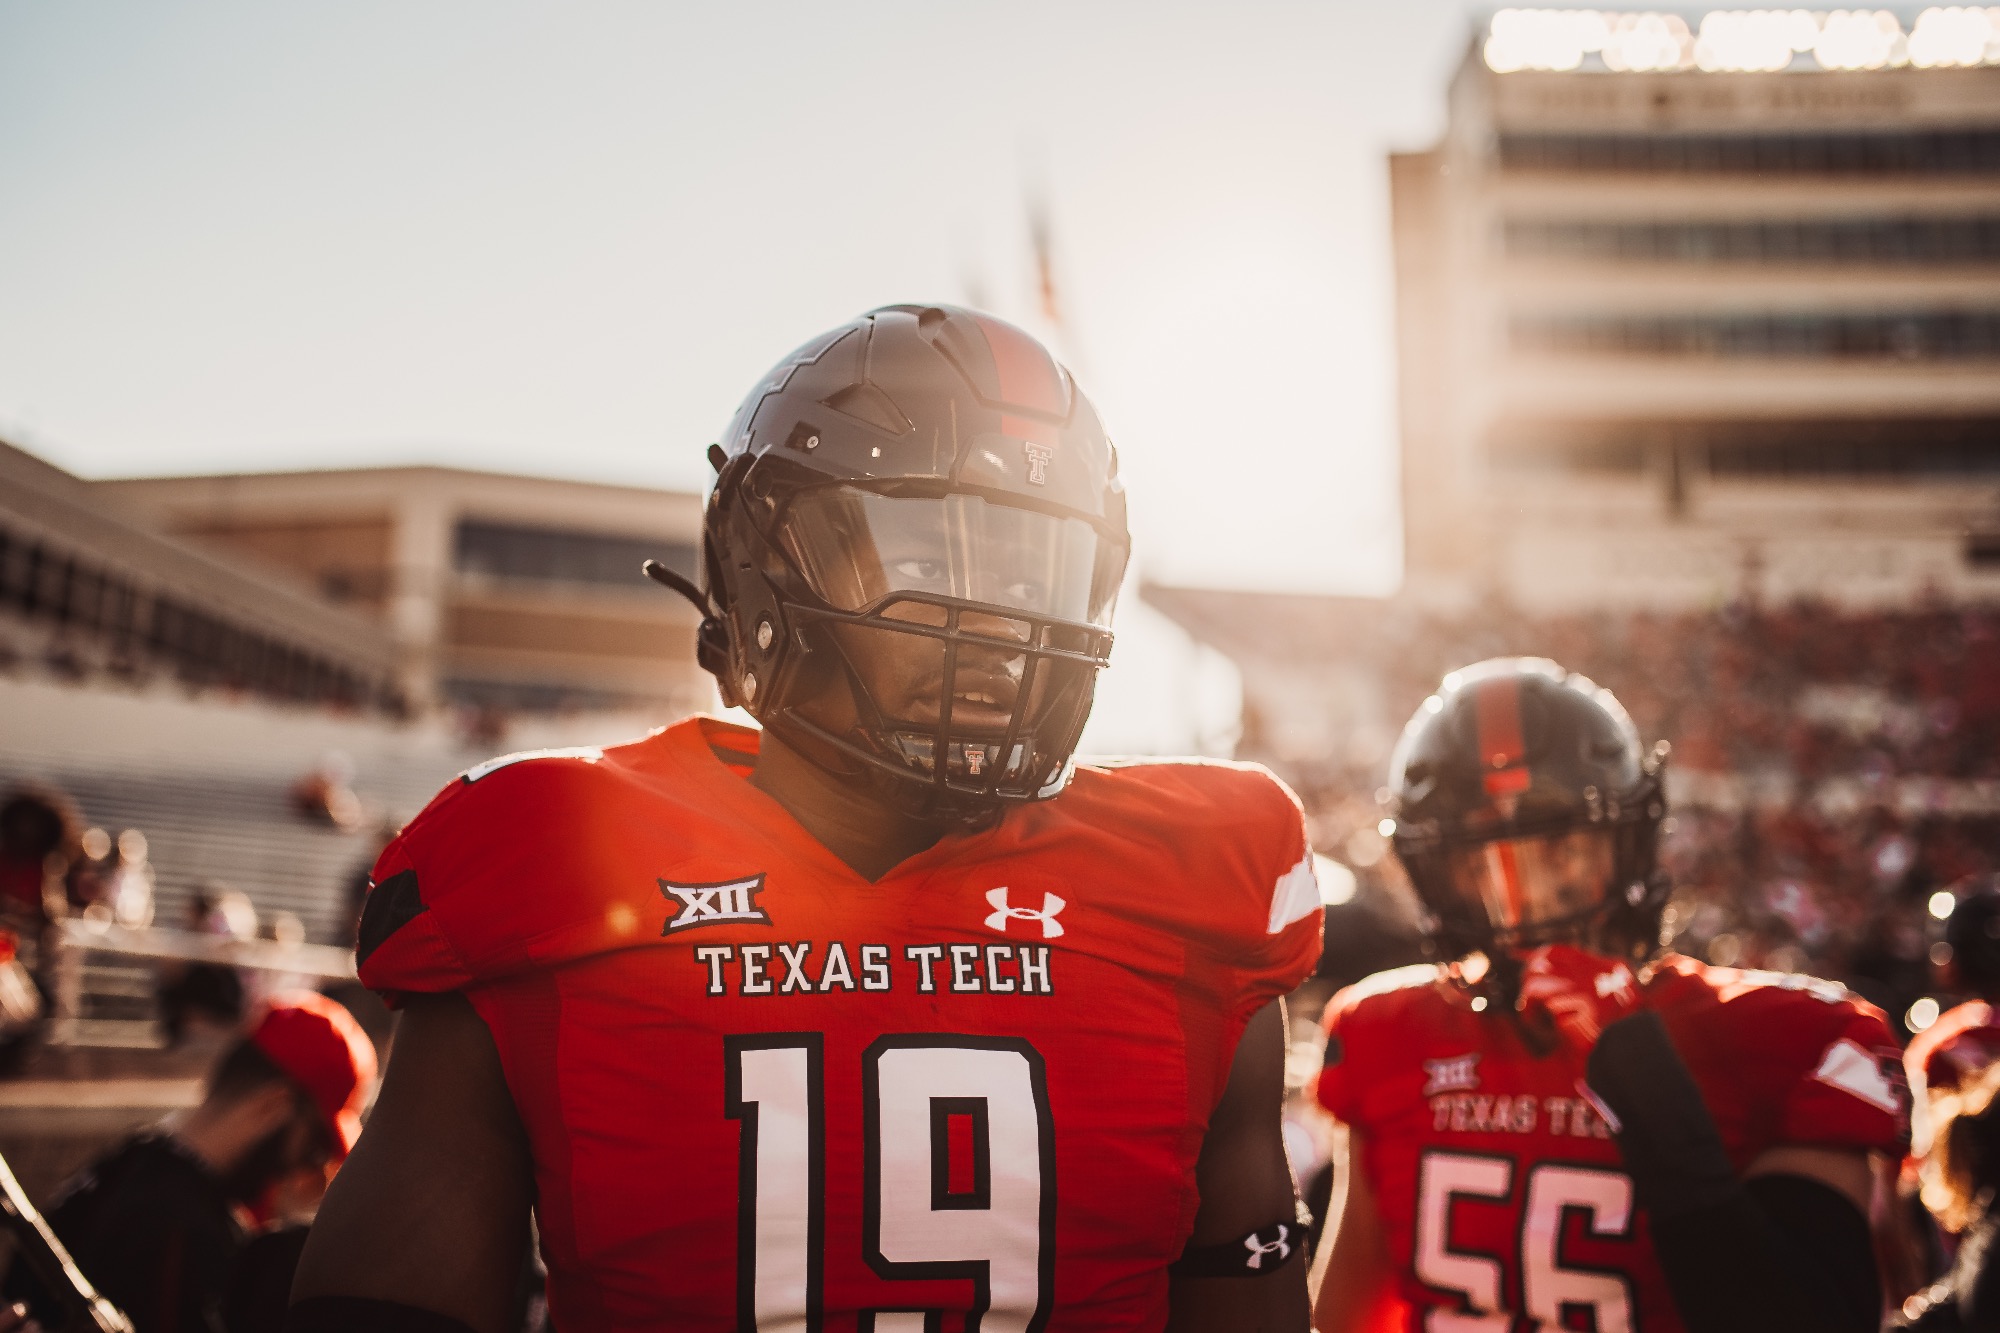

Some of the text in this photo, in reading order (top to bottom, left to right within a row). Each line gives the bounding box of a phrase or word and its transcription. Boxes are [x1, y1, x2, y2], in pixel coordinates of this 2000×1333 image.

[664, 877, 770, 930] XII
[695, 942, 1053, 995] TEXAS TECH
[1430, 1094, 1611, 1139] TEXAS TE
[724, 1032, 1057, 1333] 19
[1415, 1151, 1636, 1333] 56
